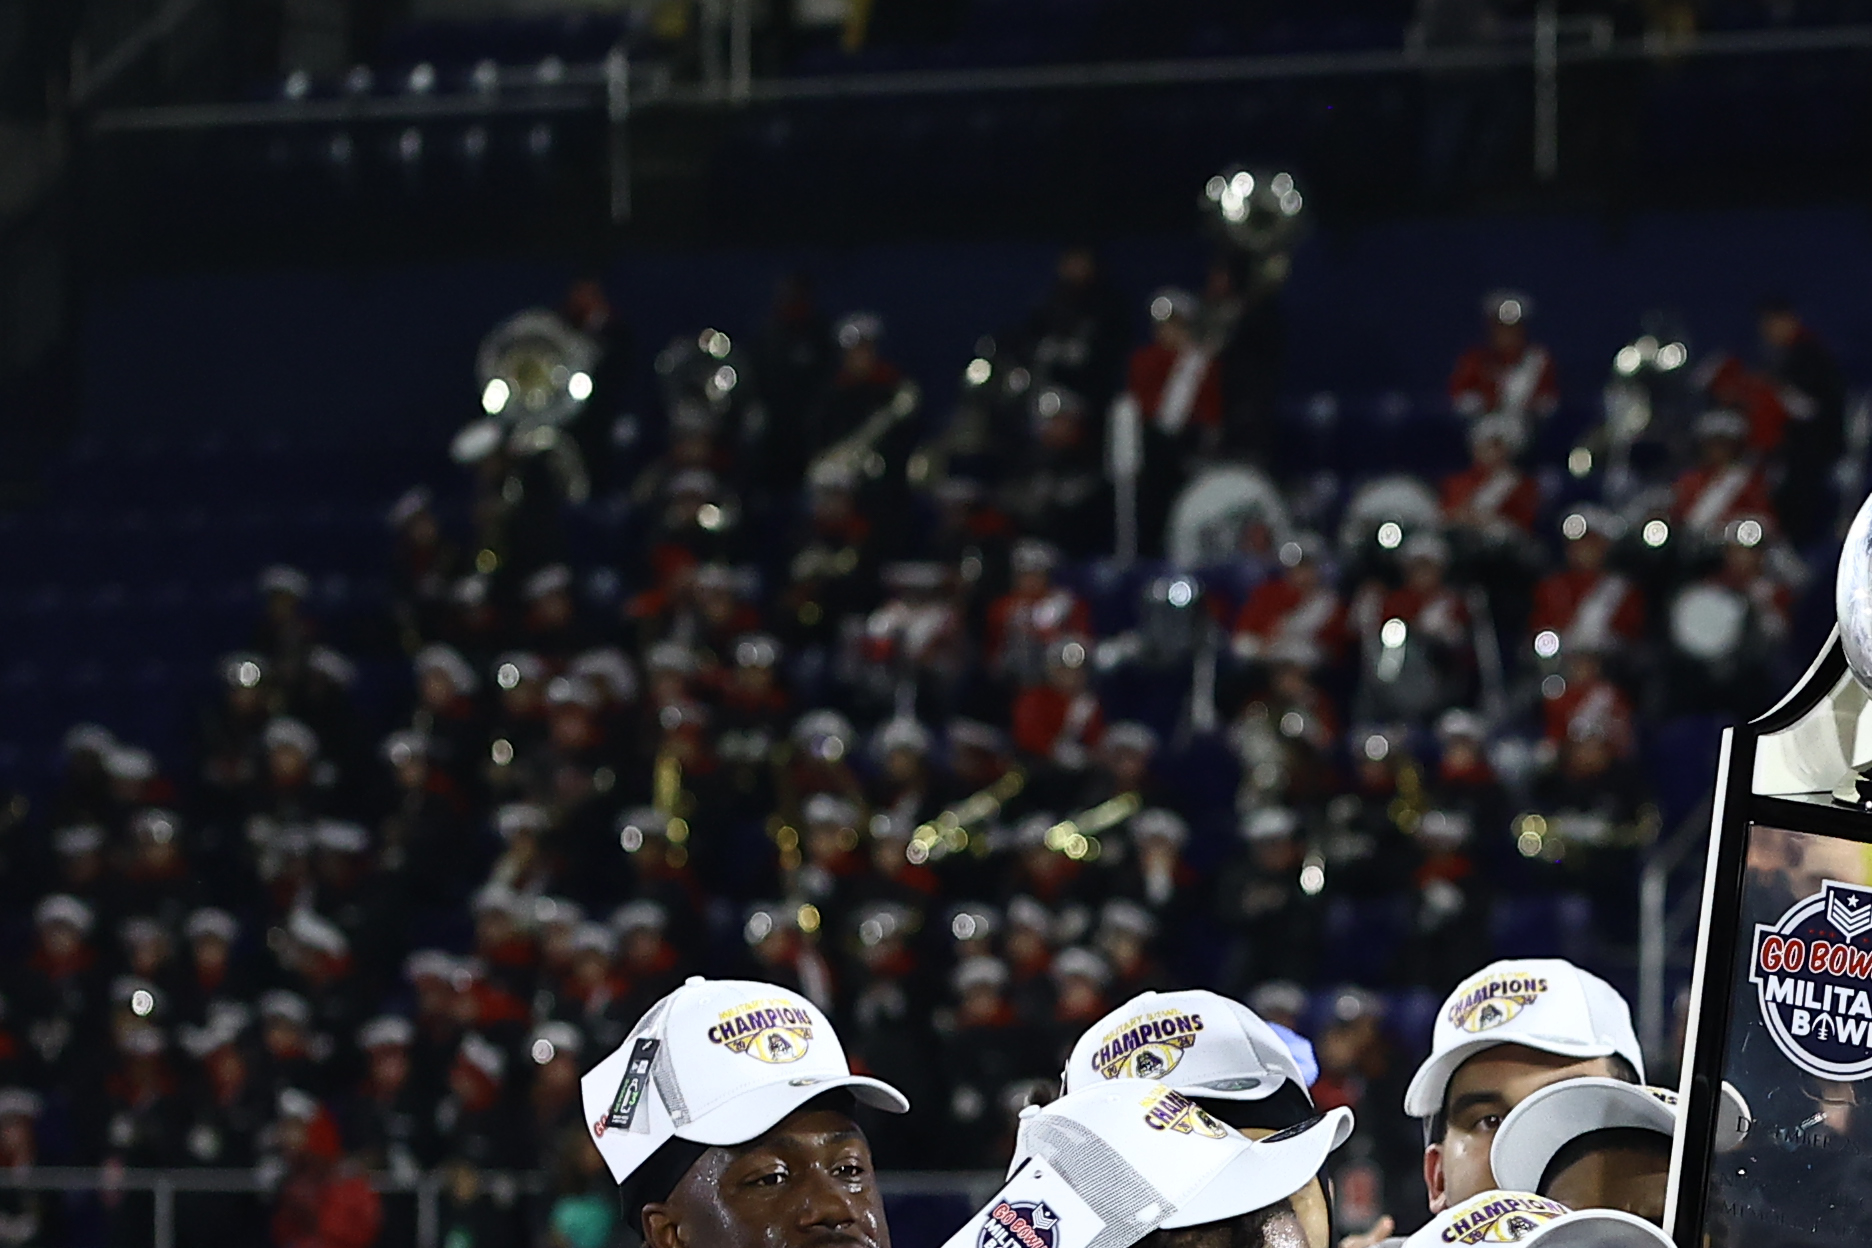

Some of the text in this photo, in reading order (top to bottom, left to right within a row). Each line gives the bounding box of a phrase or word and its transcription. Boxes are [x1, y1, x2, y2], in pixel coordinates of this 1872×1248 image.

[1760, 935, 1806, 973] GO
[1091, 1014, 1204, 1071] CHAMPIONS
[992, 1203, 1017, 1225] GO
